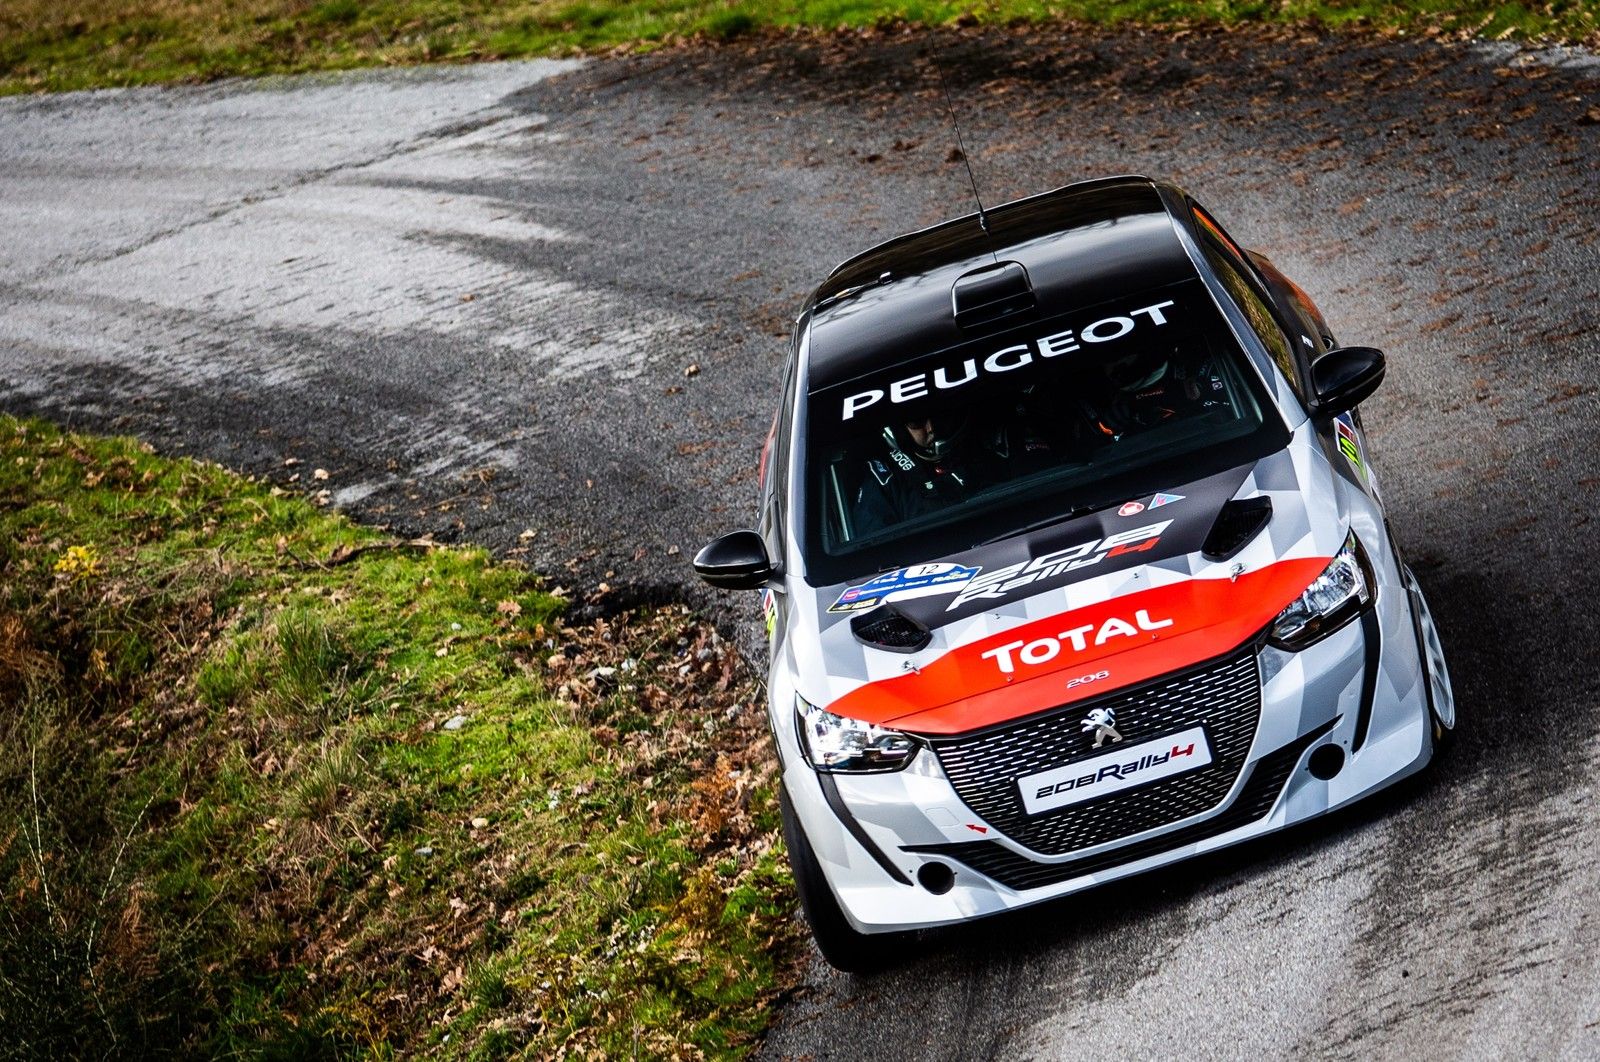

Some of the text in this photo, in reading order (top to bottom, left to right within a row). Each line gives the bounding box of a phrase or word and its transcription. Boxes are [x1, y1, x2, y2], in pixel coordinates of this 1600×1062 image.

[842, 300, 1175, 421] PEUGEOT
[889, 448, 916, 472] spar
[945, 537, 1161, 612] Rally4
[981, 609, 1174, 673] TOTAL
[1066, 670, 1110, 689] 208
